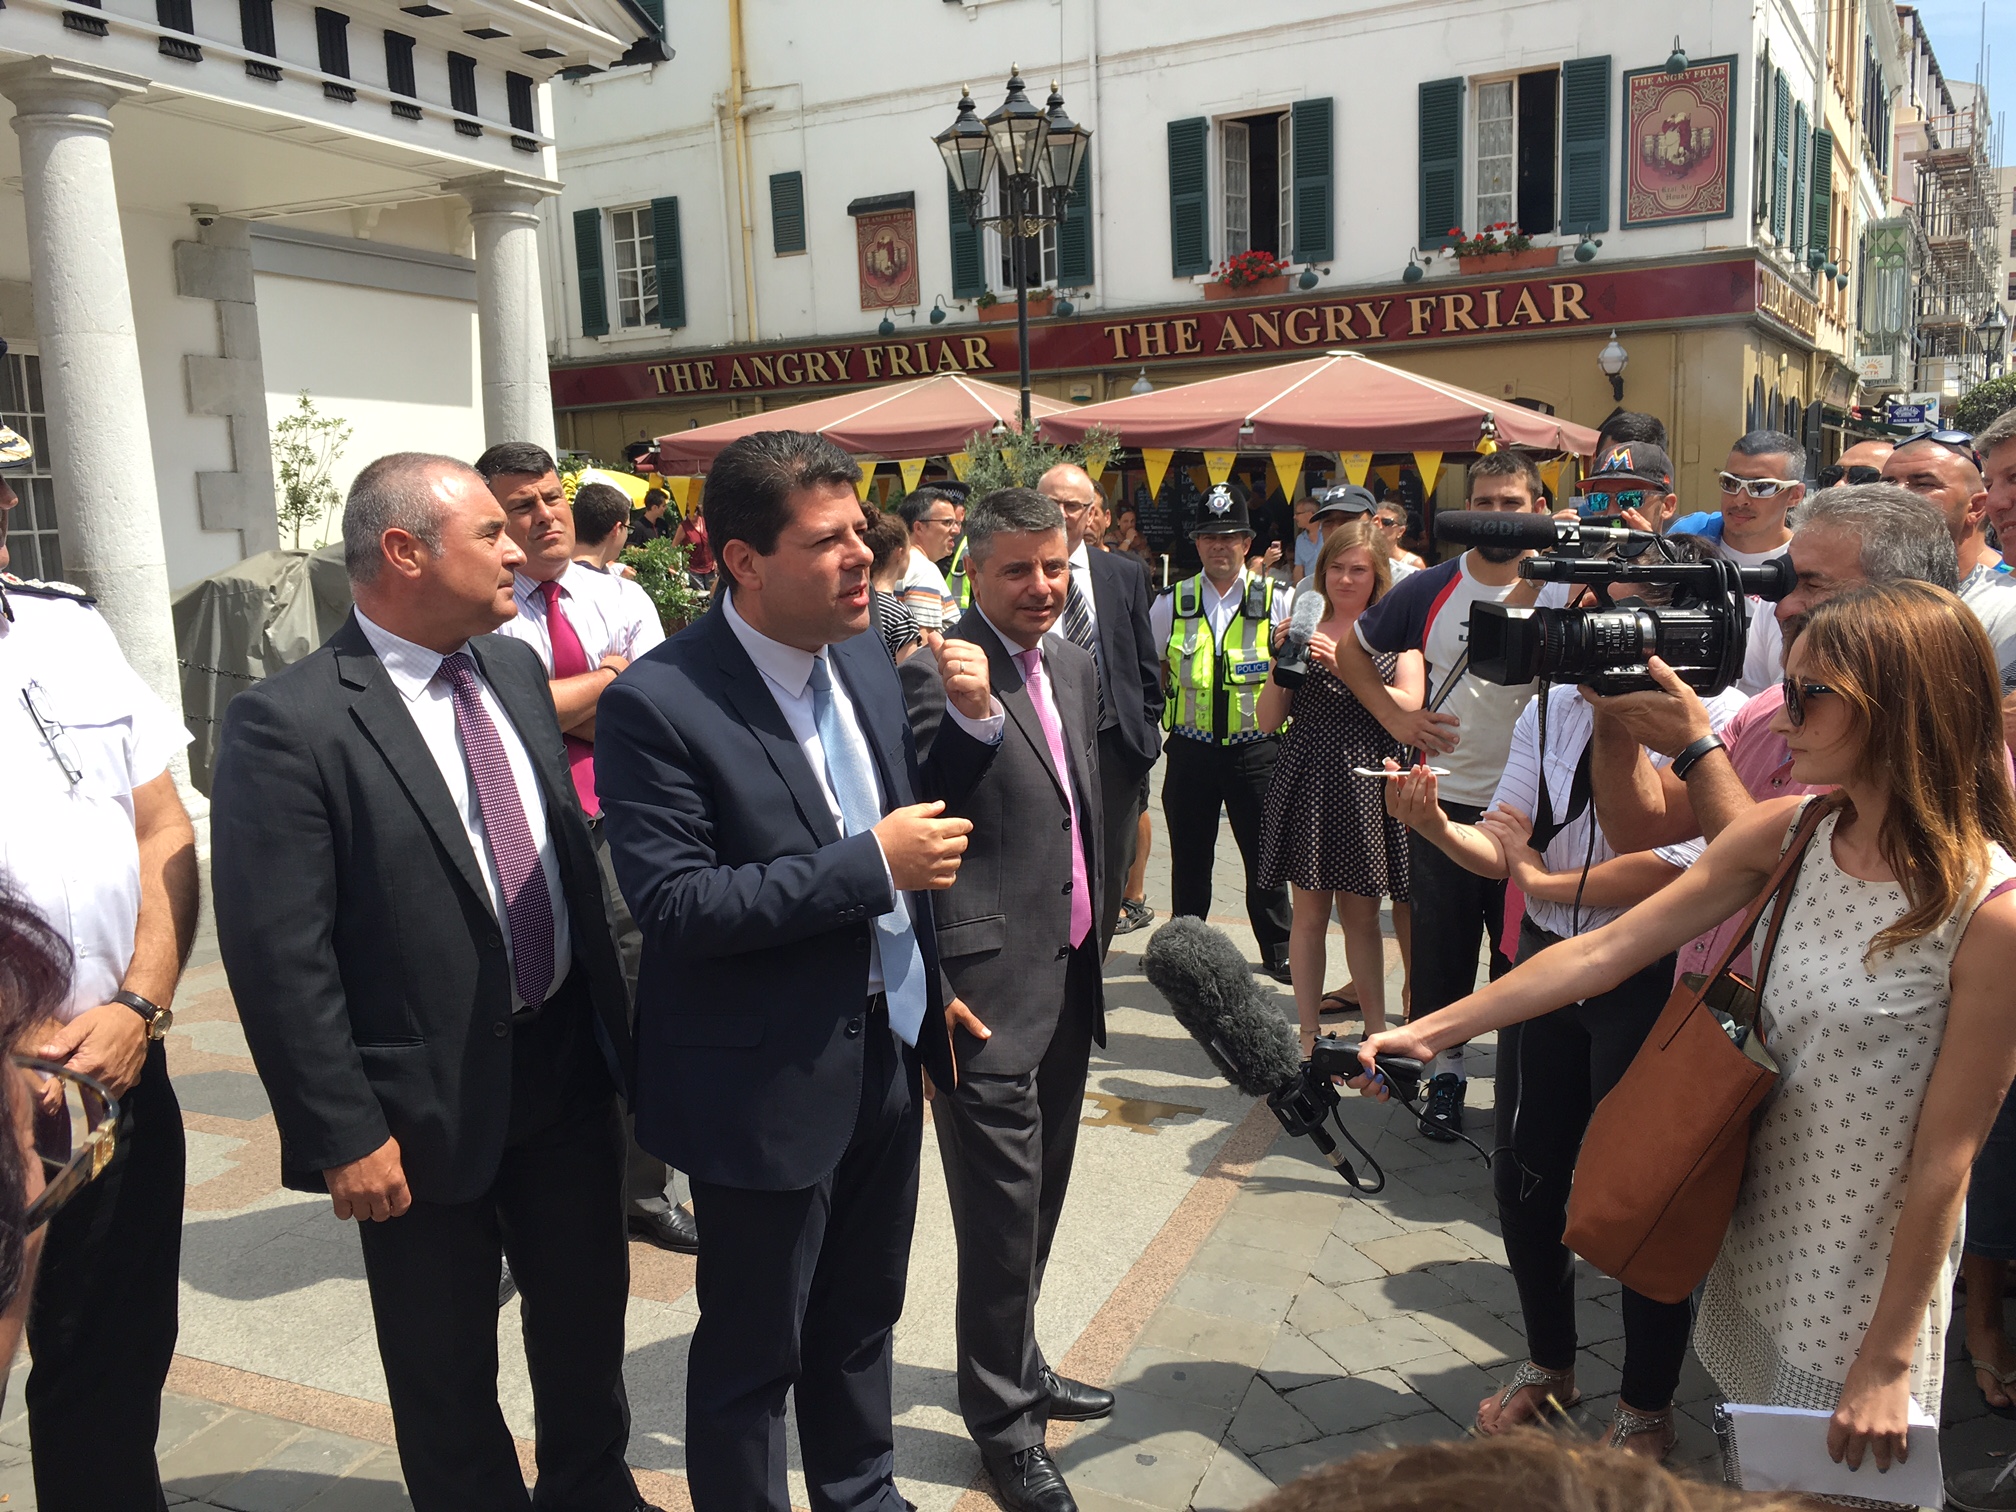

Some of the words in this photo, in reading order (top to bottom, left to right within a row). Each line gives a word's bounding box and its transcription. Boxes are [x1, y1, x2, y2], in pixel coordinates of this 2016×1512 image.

[1634, 78, 1653, 87] THE
[1656, 71, 1692, 84] ANGRY
[1694, 67, 1725, 79] FRIAR
[1104, 319, 1201, 360] THE
[1215, 300, 1394, 351] ANGRY
[1406, 282, 1591, 336] FRIAR
[648, 360, 719, 395] THE
[728, 349, 853, 389] ANGRY
[861, 337, 994, 379] FRIAR
[1236, 662, 1268, 675] POLICE
